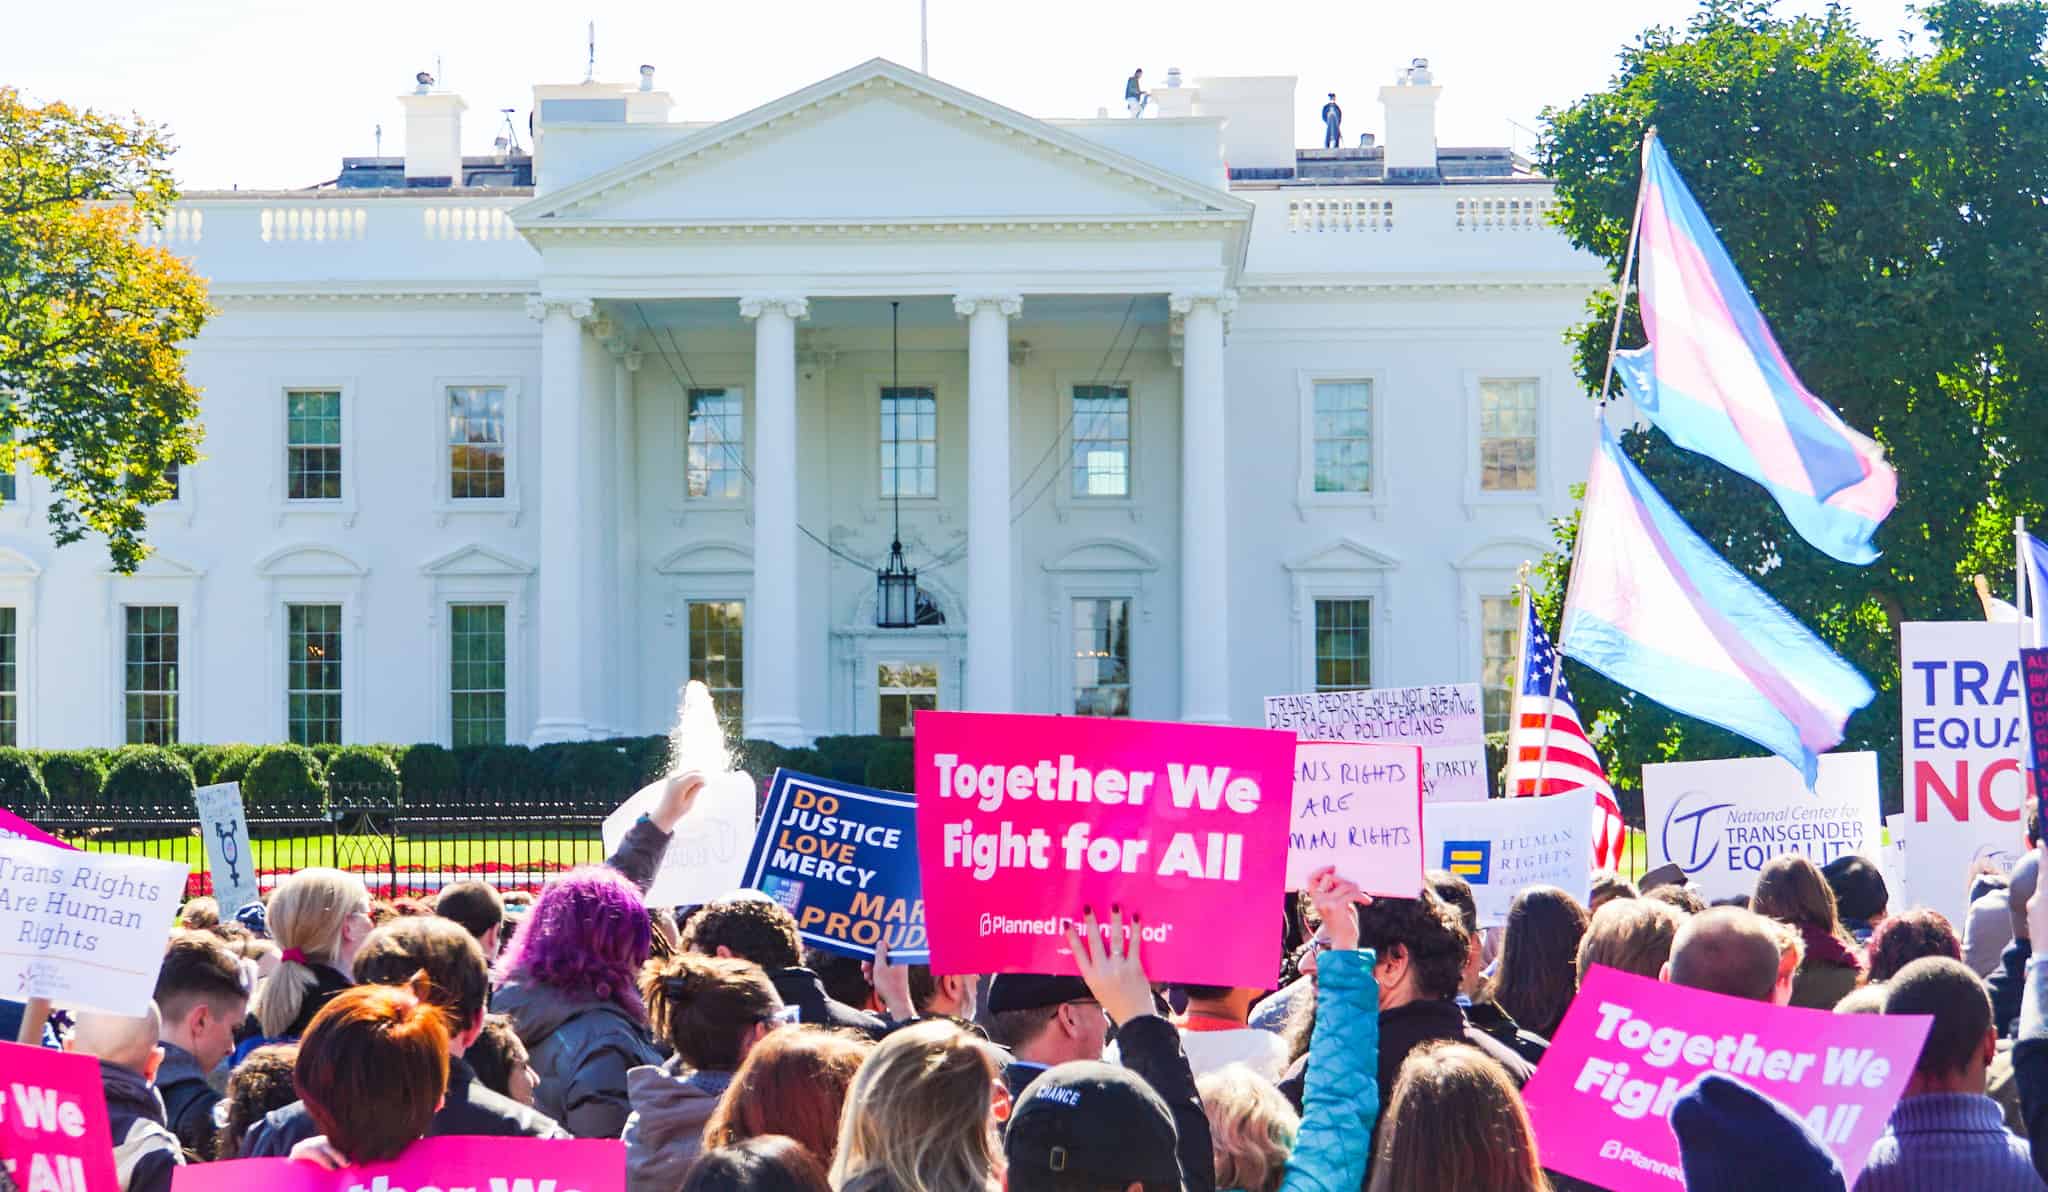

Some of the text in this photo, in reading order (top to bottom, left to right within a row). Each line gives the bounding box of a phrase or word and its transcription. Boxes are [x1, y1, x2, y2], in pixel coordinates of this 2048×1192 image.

[1269, 696, 1313, 712] TRANS
[1320, 691, 1364, 709] PEOPLE
[1402, 687, 1423, 704] NOT
[1430, 686, 1446, 702] BE
[1453, 686, 1460, 701] A
[1912, 661, 2020, 706] TRA
[1269, 708, 1359, 730] DISTRACTION
[1303, 717, 1445, 741] WEAK POLITICIANS
[1913, 717, 2020, 750] EQUA
[934, 753, 1154, 812] Together
[1166, 762, 1261, 814] We
[1340, 763, 1406, 784] RIGHTS
[1436, 760, 1476, 777] PARTY
[793, 789, 839, 815] DO
[1300, 792, 1354, 818] ARE
[1914, 758, 2021, 822] NO
[782, 808, 902, 850] JUSTICE
[1727, 804, 1789, 825] National
[1791, 803, 1838, 821] Center
[779, 830, 857, 864] LOVE
[1289, 825, 1411, 850] MAN RIGHTS
[1502, 829, 1573, 850] HUMAN
[1725, 820, 1864, 844] TRANSGENDER
[943, 819, 1243, 882] Fight for All
[0, 857, 161, 902] Trans Rights
[770, 849, 877, 888] MERCY
[0, 888, 142, 929] Are Human
[849, 891, 925, 924] MAR
[17, 920, 100, 952] Rights
[799, 905, 927, 949] PROUD
[993, 915, 1057, 937] Planned
[1594, 1001, 1890, 1089] Together We
[1573, 1056, 1682, 1120] Figh
[10, 1081, 87, 1138] We
[1620, 1146, 1685, 1182] Planne
